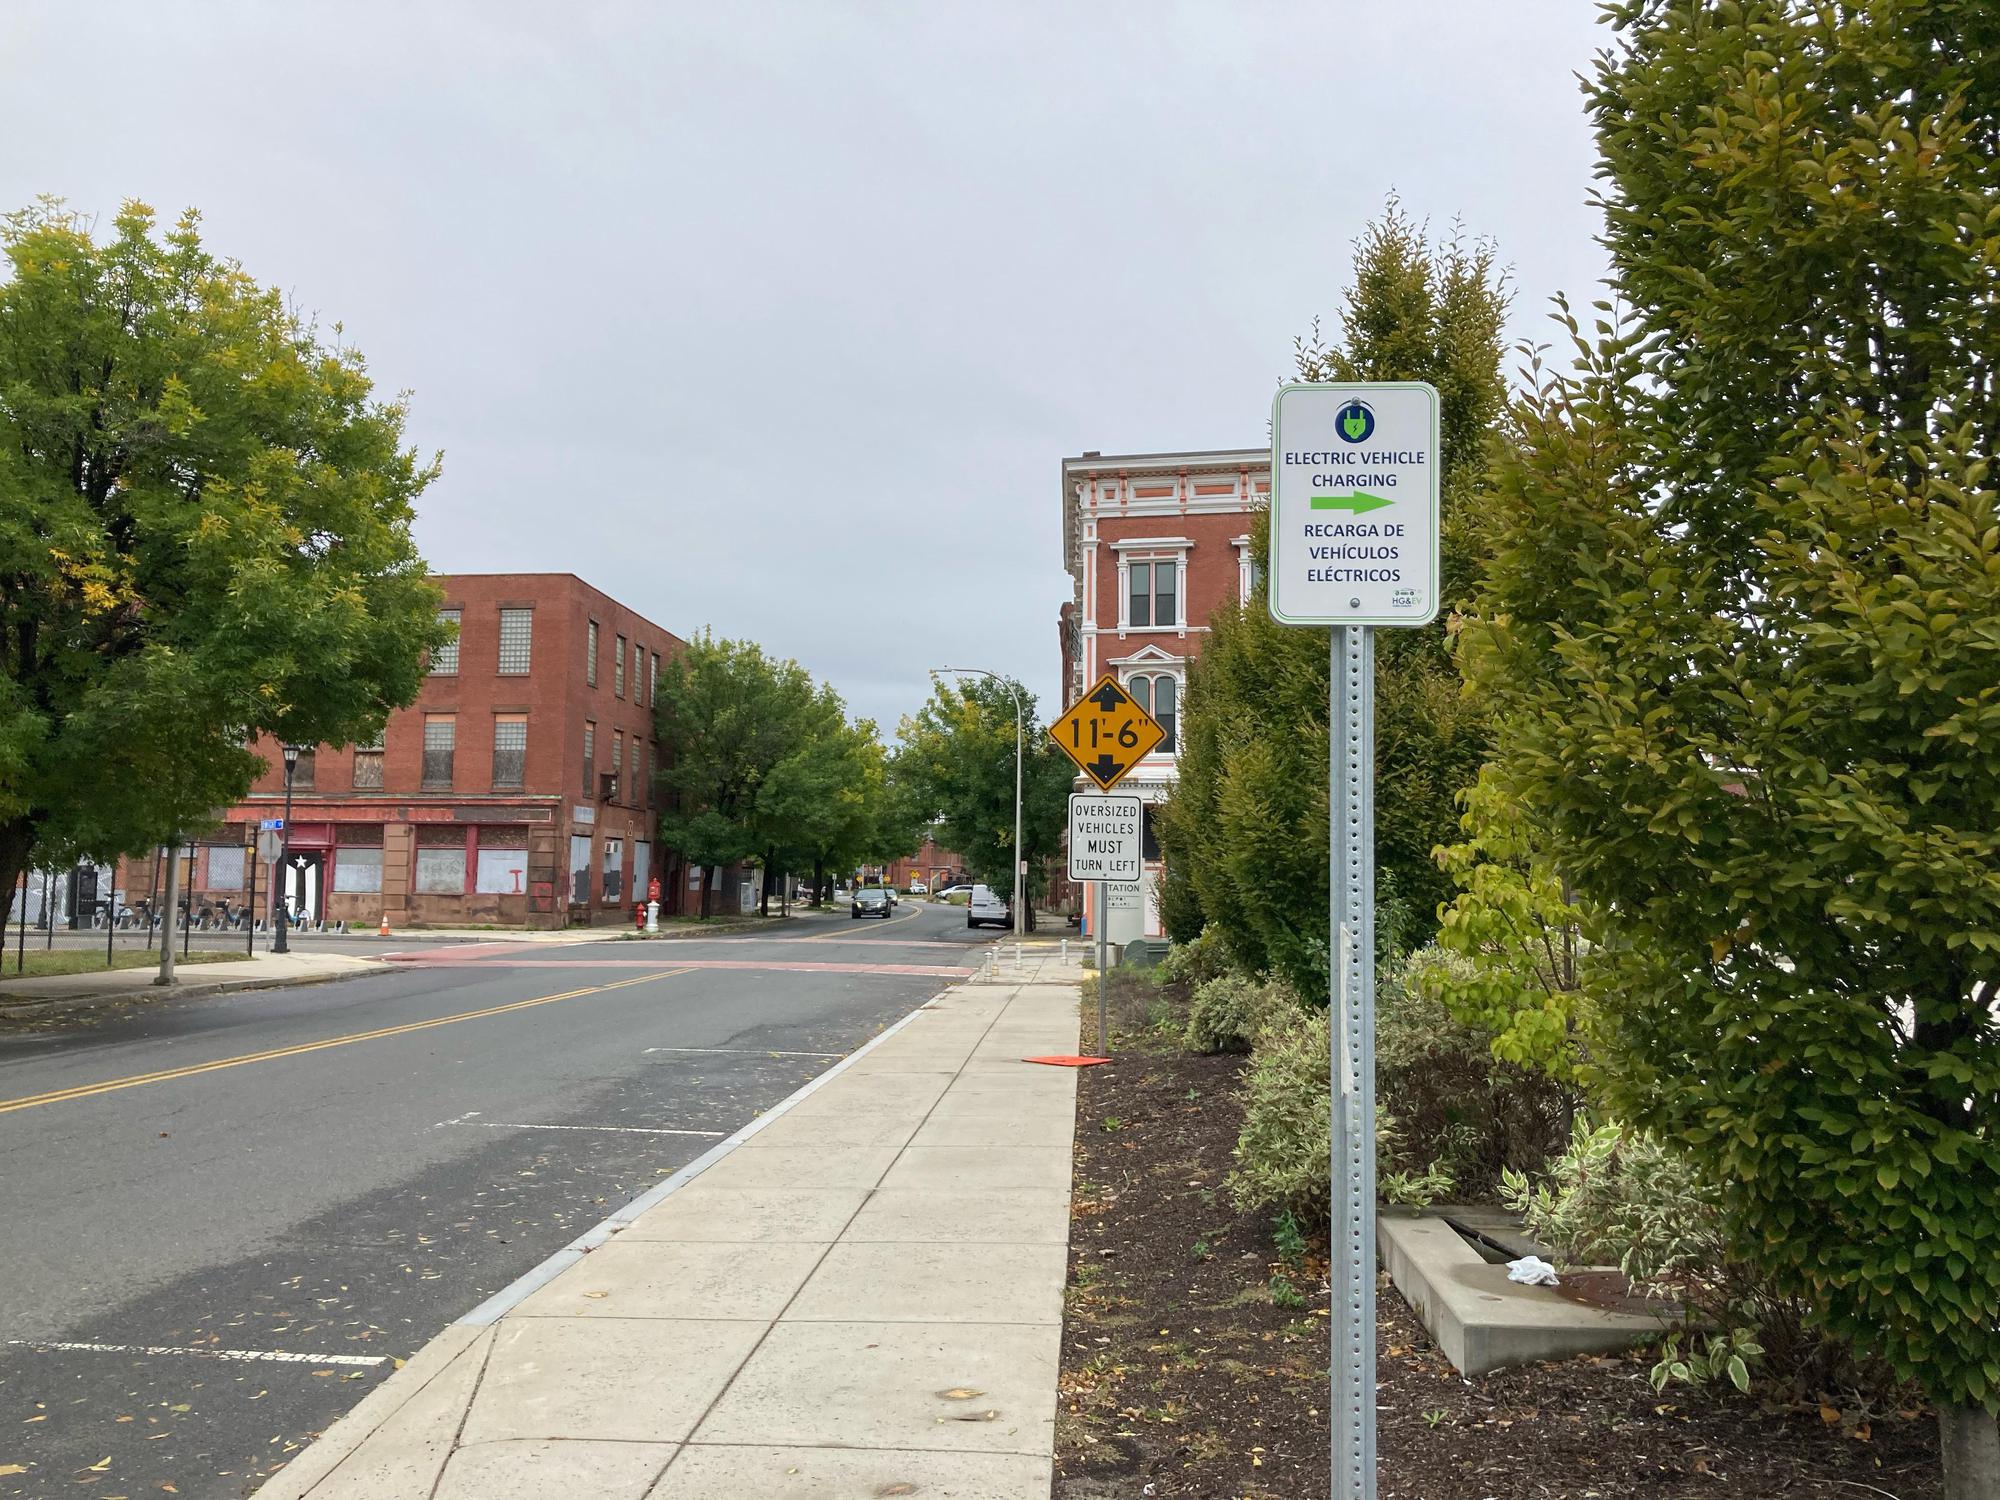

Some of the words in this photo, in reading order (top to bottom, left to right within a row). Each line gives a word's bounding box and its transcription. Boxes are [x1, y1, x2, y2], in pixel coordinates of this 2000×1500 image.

[1285, 452, 1356, 465] ELECTRIC
[1360, 451, 1425, 464] VEHICLE
[1312, 474, 1397, 487] CHARGING
[1304, 524, 1379, 537] RECARGA
[1384, 524, 1405, 537] DE
[1309, 543, 1399, 560] VEHÍCULOS
[1307, 566, 1401, 582] ELÉCTRICOS
[1075, 805, 1137, 817] OVERSIZED
[1077, 823, 1134, 834] VEHICLES
[1087, 840, 1123, 854] MUST
[1075, 859, 1102, 871] TURN
[1109, 859, 1135, 871] LEFT
[1107, 884, 1140, 892] TATION
